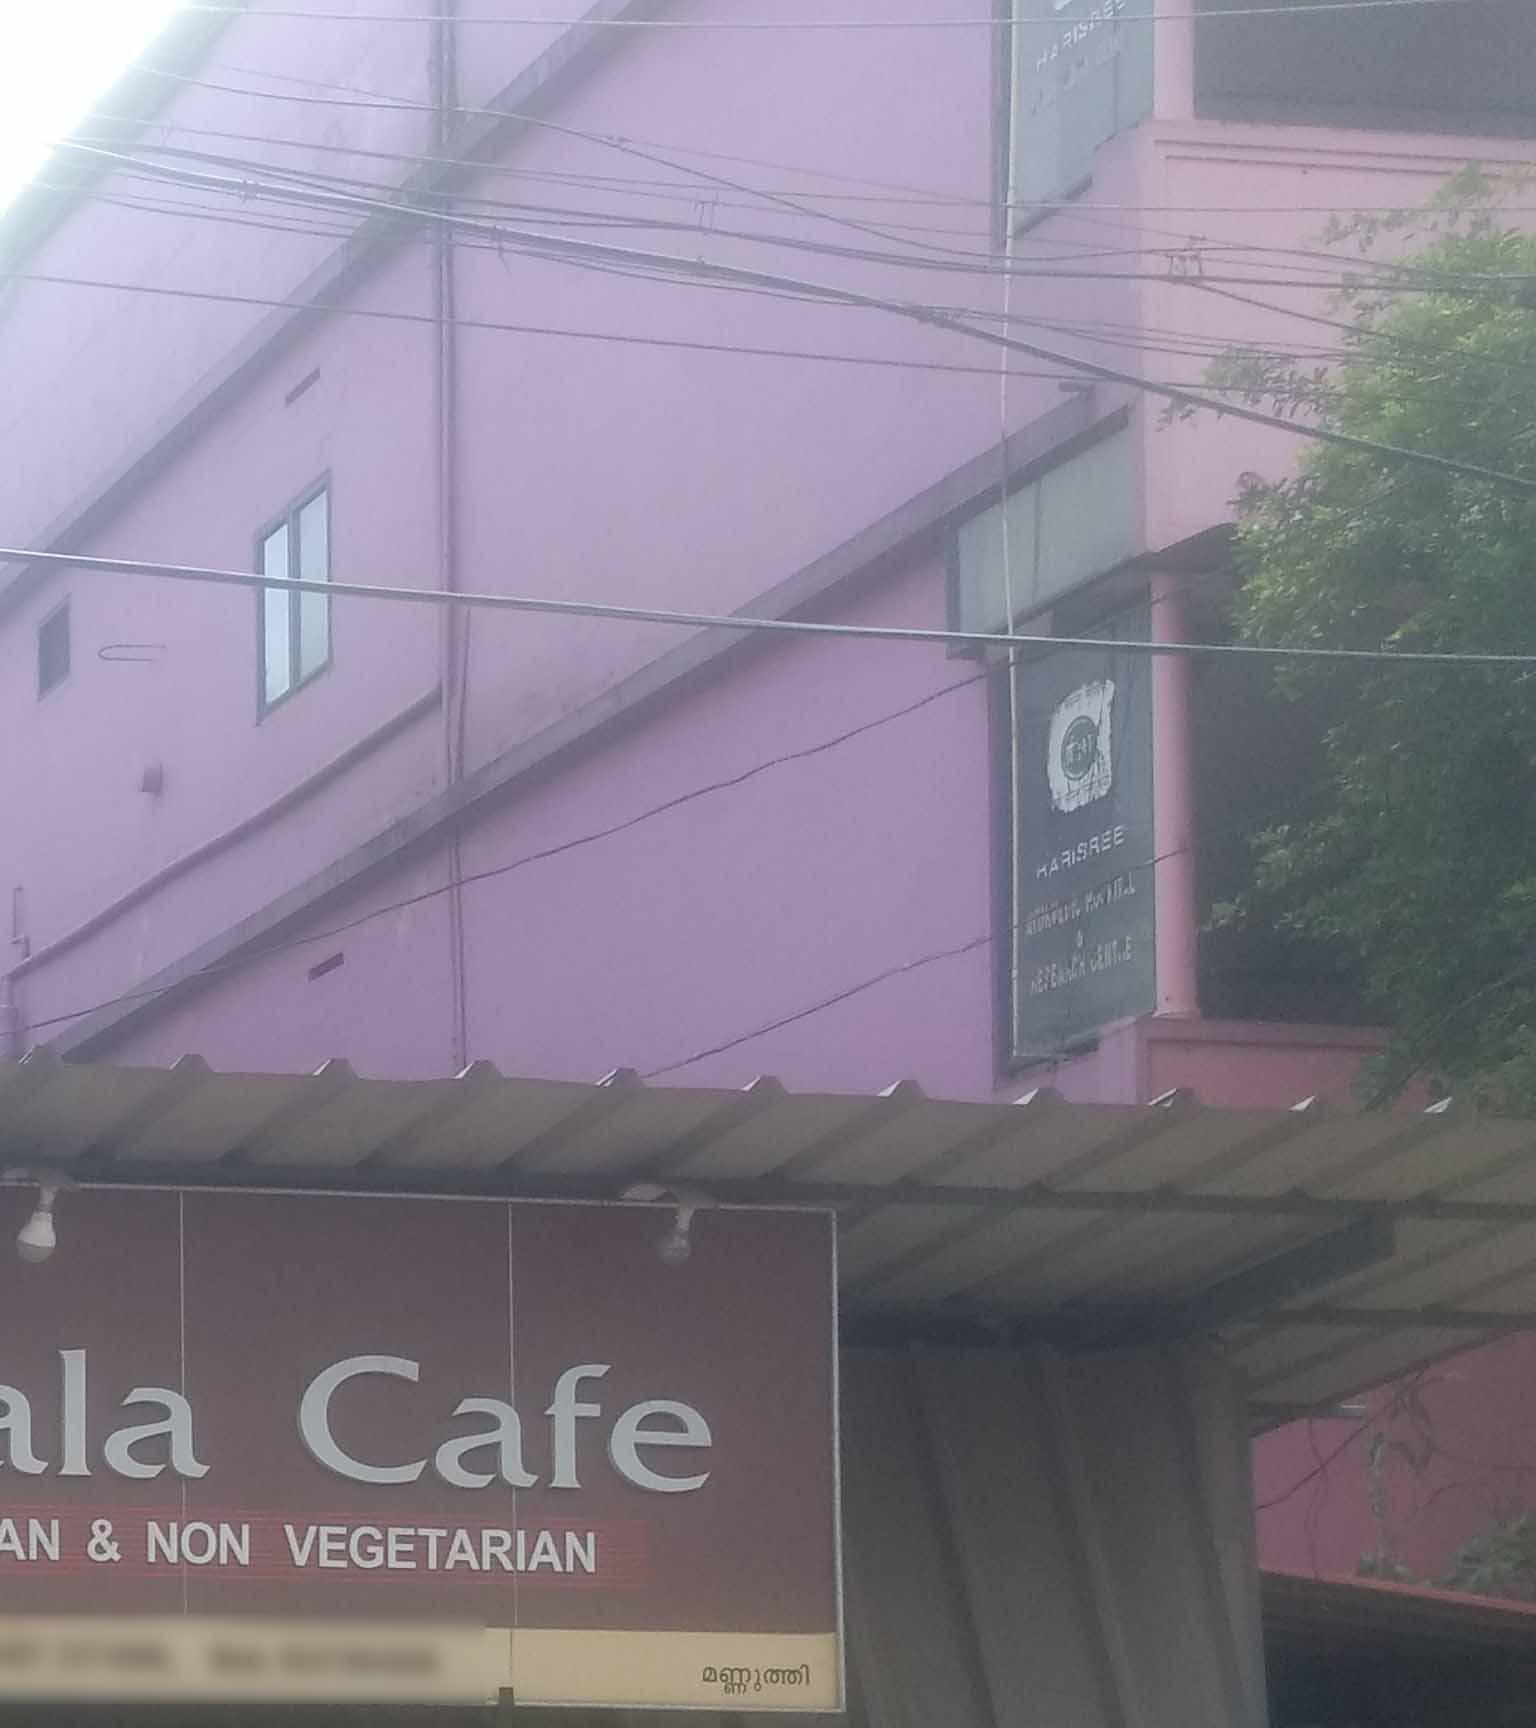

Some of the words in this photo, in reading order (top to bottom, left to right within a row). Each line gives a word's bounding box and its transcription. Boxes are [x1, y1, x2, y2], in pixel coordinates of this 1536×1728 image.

[1035, 825, 1126, 879] HARISREE
[297, 1354, 715, 1495] Cafe
[86, 1518, 122, 1564] &
[145, 1521, 251, 1567] NON
[283, 1523, 597, 1575] VEGETARIAN
[702, 1663, 811, 1695] മണ്ണുത്തി
